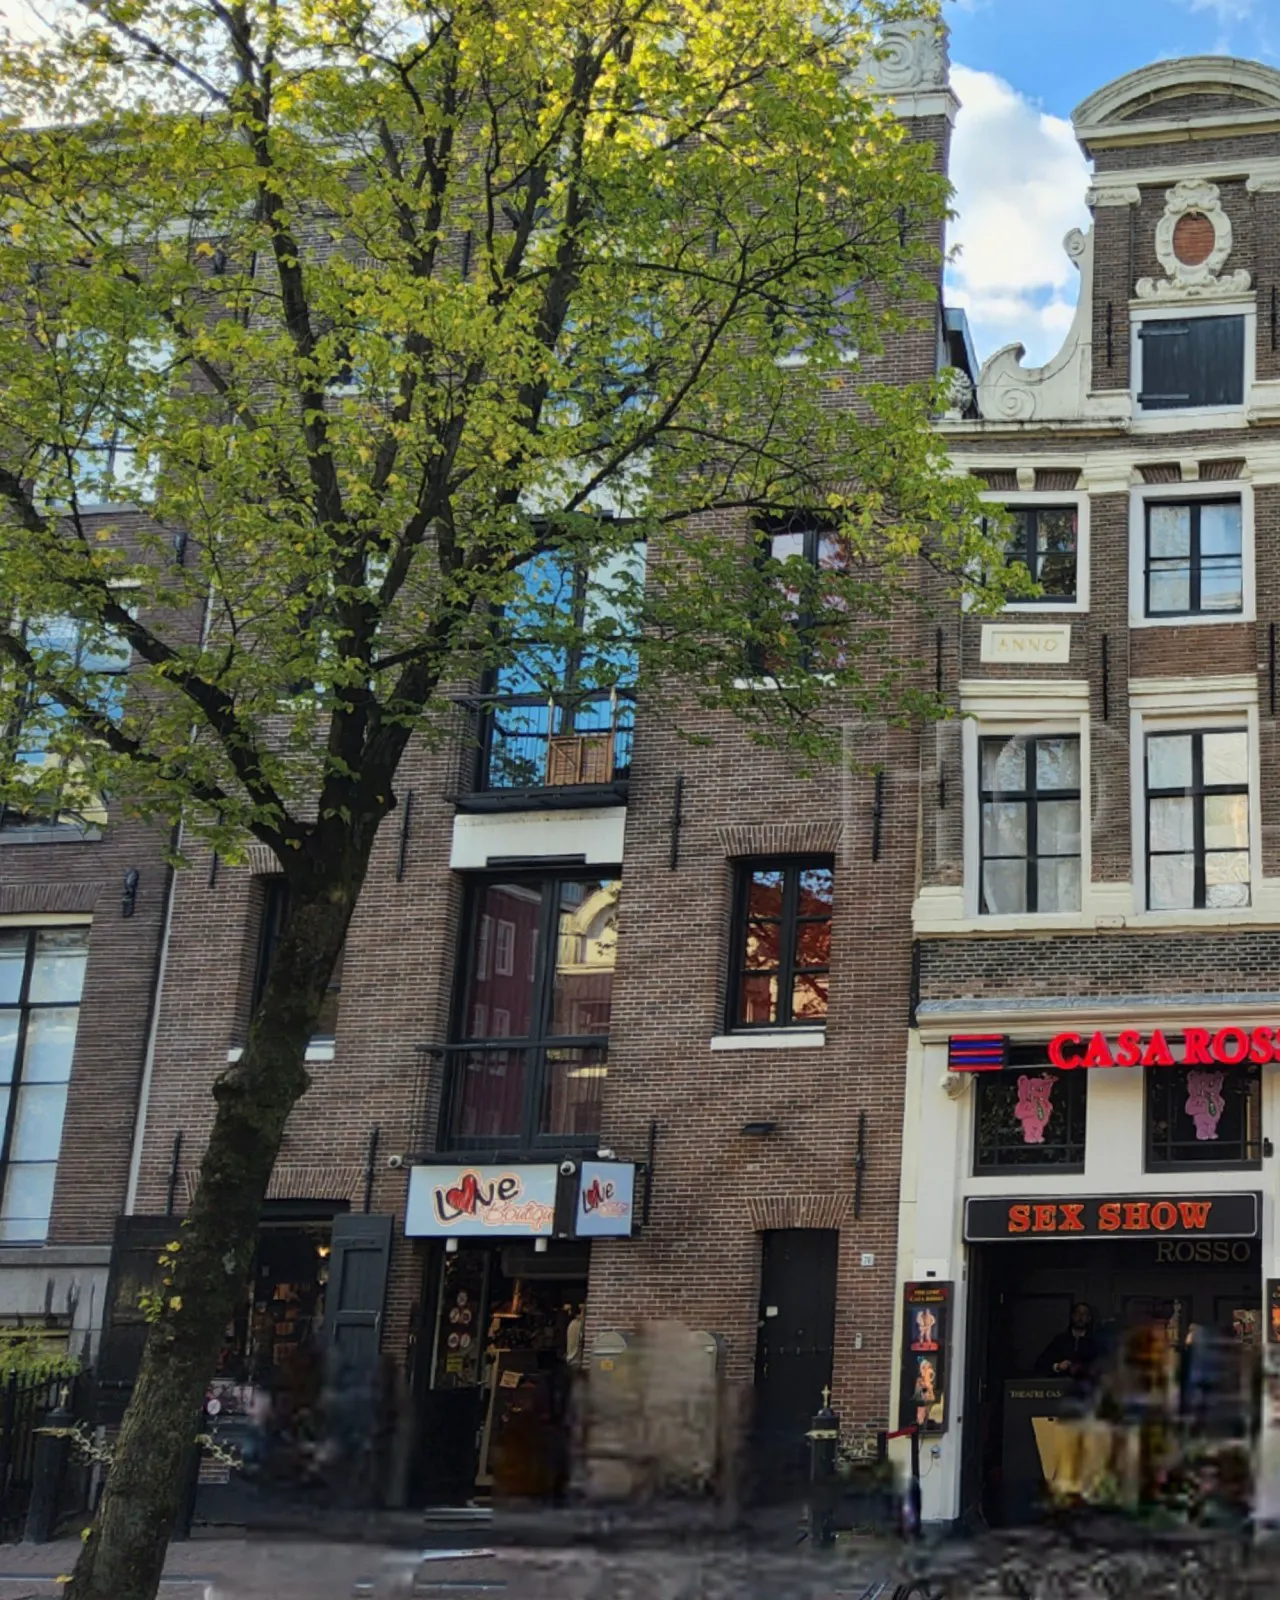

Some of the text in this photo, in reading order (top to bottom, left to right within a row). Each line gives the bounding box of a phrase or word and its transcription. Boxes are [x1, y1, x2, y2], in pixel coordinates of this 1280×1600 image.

[996, 636, 1059, 652] ANNO
[1047, 1029, 1176, 1069] CASA
[1008, 1202, 1212, 1232] SEX SHOW
[1156, 1241, 1251, 1262] ROSSO
